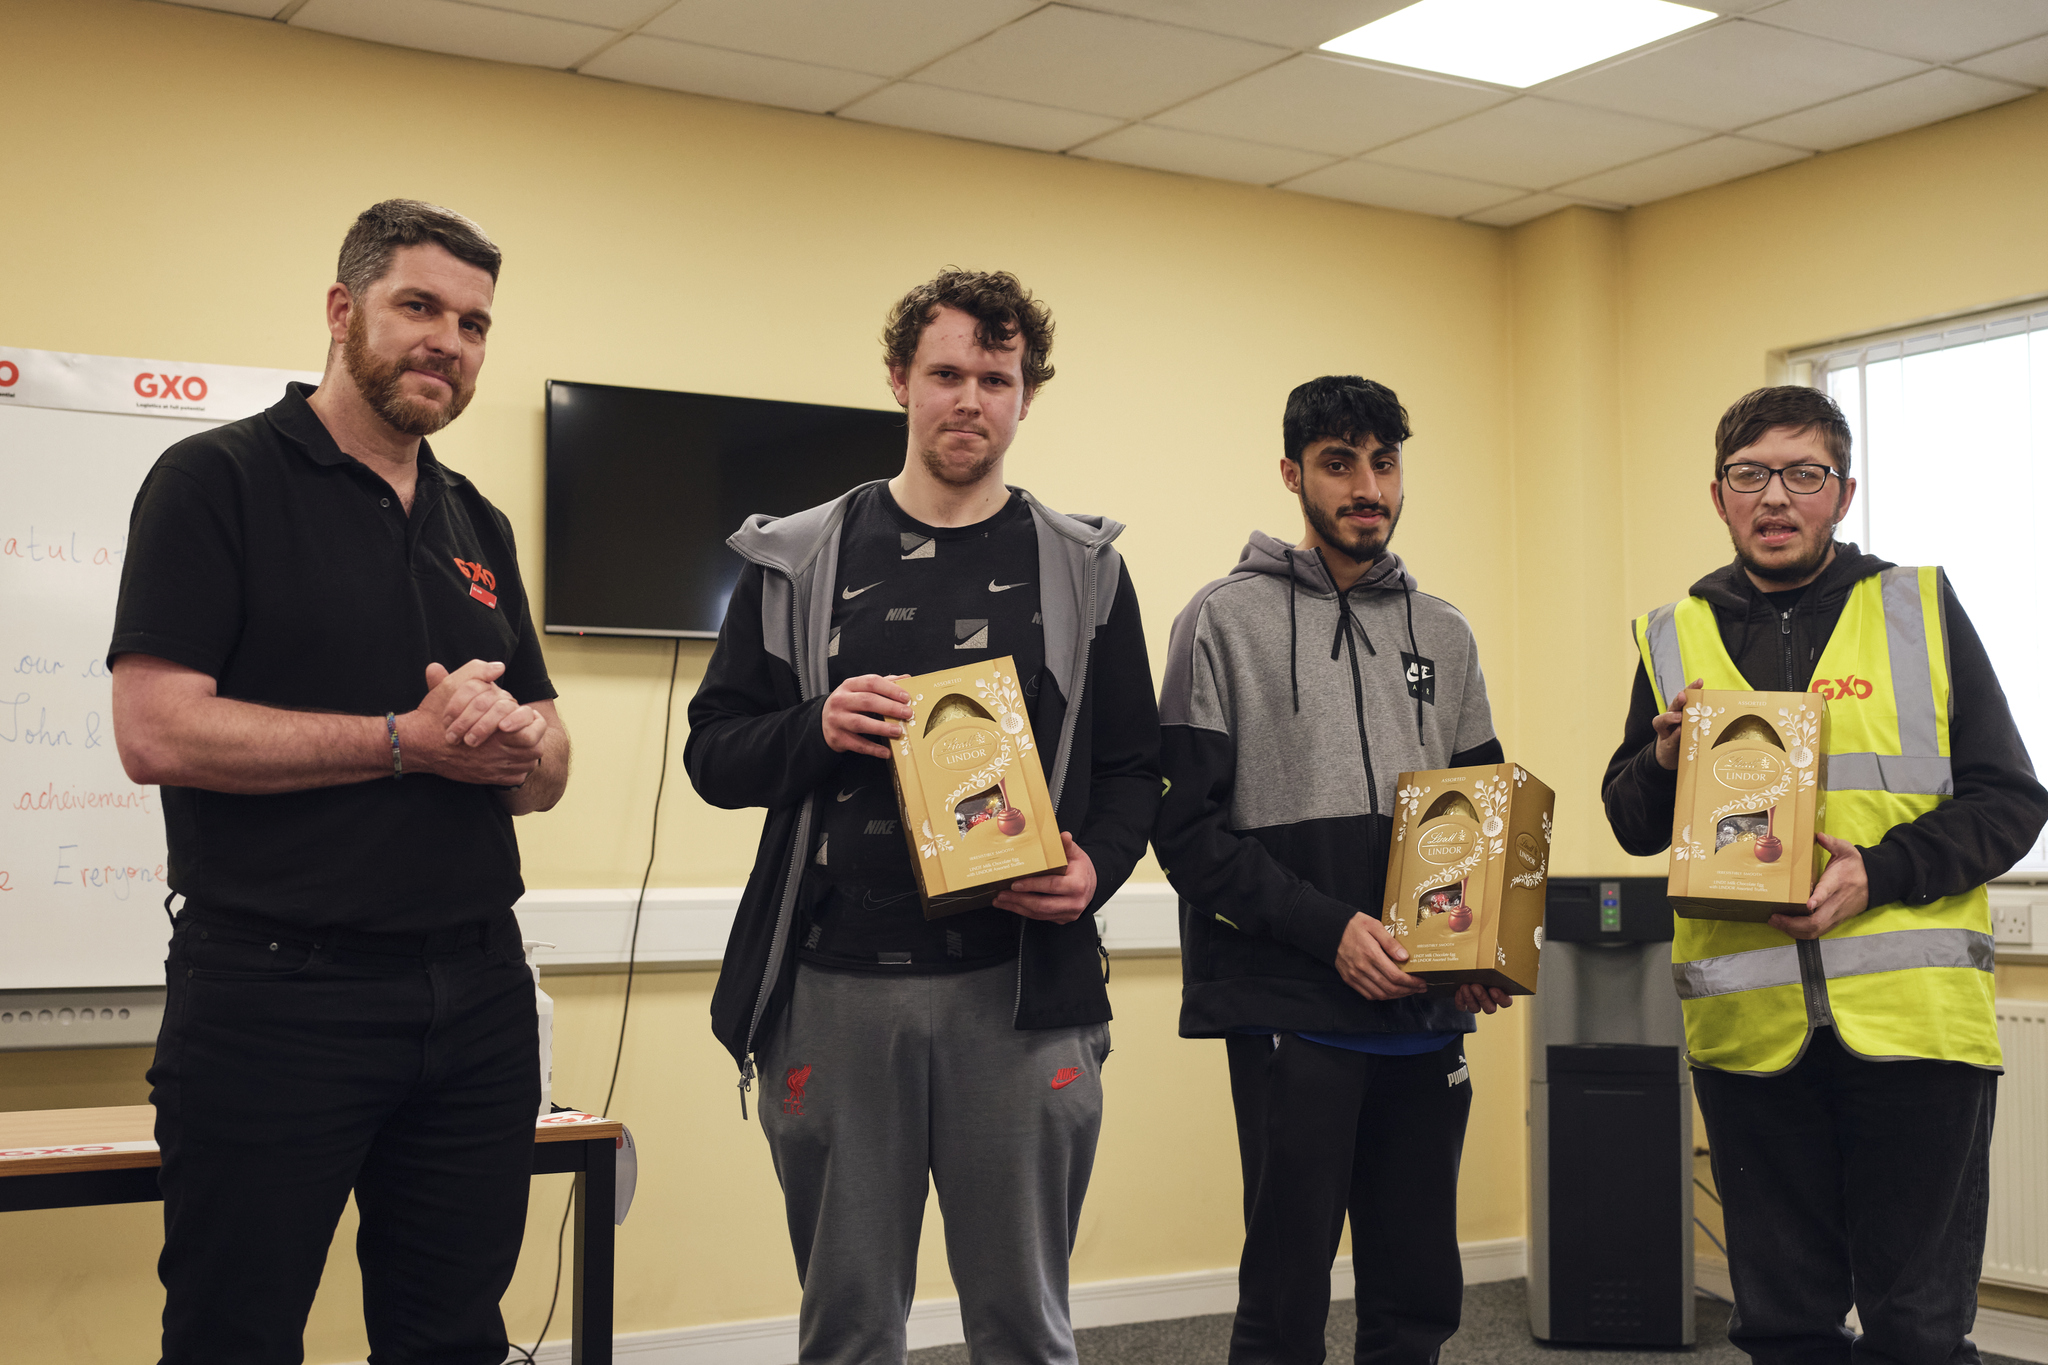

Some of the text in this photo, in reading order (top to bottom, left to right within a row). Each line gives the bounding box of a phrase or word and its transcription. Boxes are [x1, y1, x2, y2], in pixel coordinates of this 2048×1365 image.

[134, 372, 208, 401] GXO
[453, 557, 496, 591] GXO
[885, 607, 917, 621] NIKE
[14, 655, 64, 674] our
[934, 677, 962, 688] ASSORTED
[1811, 674, 1873, 701] GXO
[0, 692, 102, 749] John &
[945, 748, 987, 764] LINDOR
[1726, 772, 1766, 781] LINDOR
[863, 820, 898, 835] NIKE
[1427, 831, 1458, 844] Lindt
[1428, 846, 1462, 856] LINDOR
[1519, 850, 1536, 866] LINDOR
[946, 929, 963, 959] NIKE
[1056, 1066, 1078, 1081] NIKE
[783, 1103, 805, 1116] LFC
[0, 1146, 114, 1157] GXO
